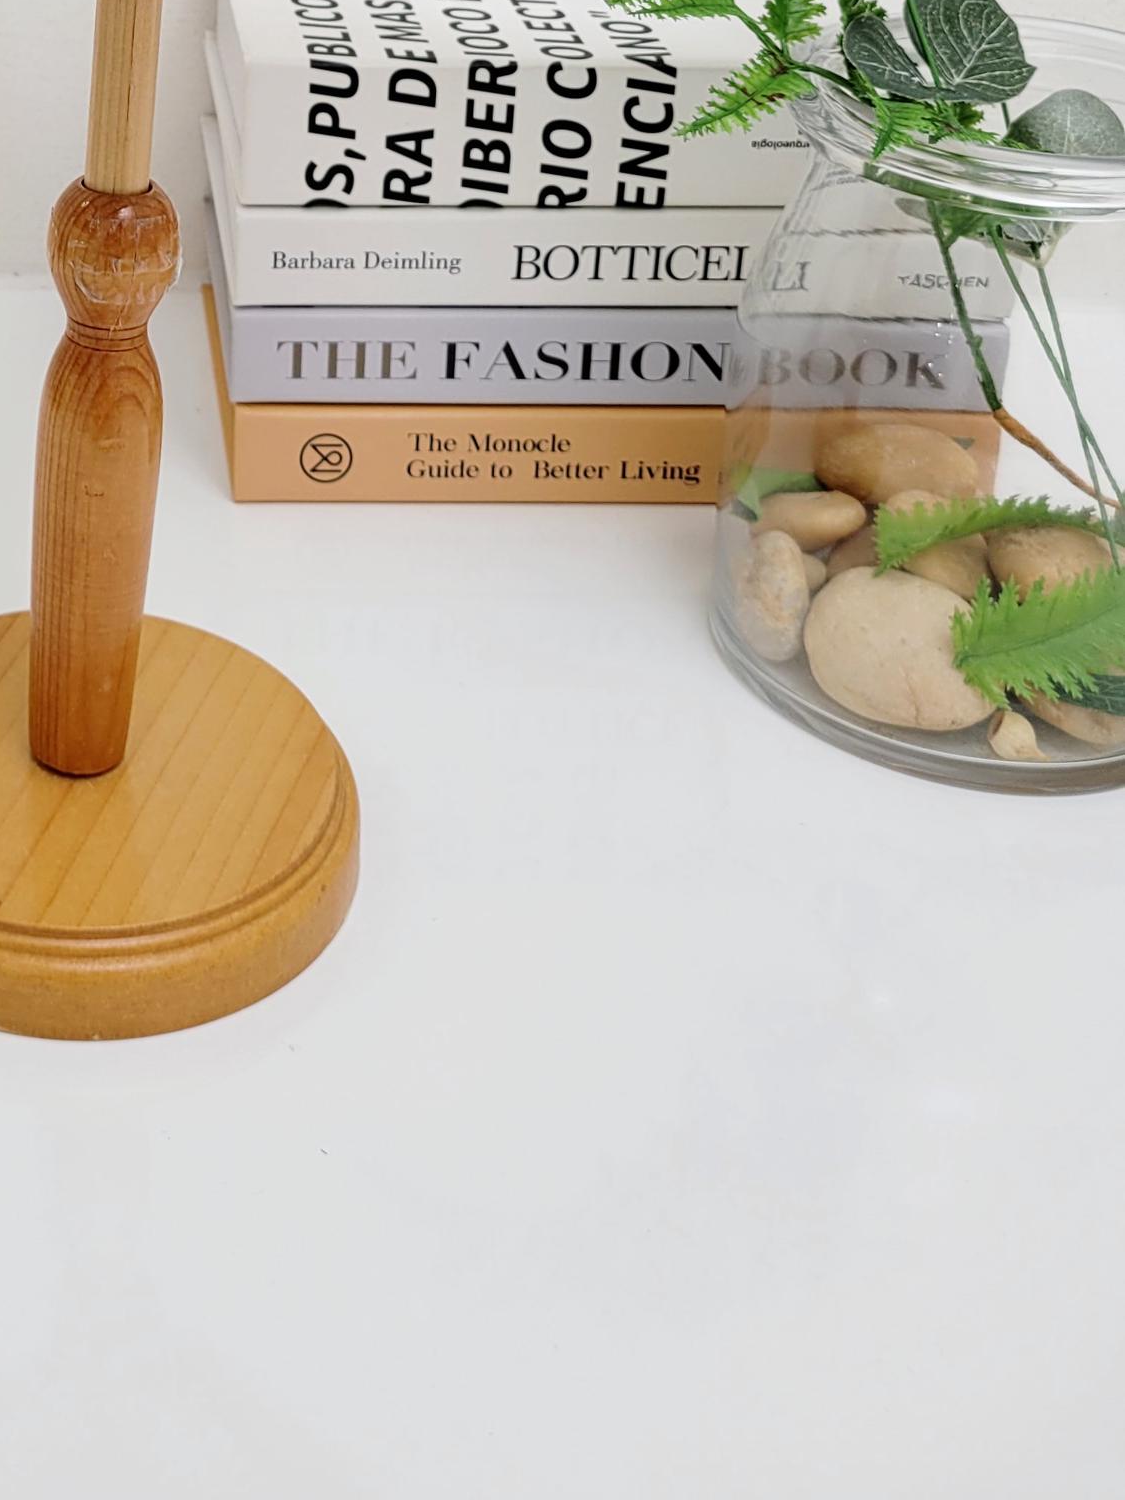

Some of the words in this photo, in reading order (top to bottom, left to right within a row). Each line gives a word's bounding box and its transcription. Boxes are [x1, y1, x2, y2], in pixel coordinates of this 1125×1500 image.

[384, 47, 438, 108] DE
[383, 128, 435, 205] RA
[272, 251, 355, 270] Barbara
[363, 251, 462, 274] Deimling
[276, 341, 417, 380] THE
[439, 341, 731, 381] FASHON
[757, 348, 947, 390] BOOK
[408, 433, 457, 452] The
[467, 433, 571, 452] Monocle
[406, 459, 479, 479] Guide
[490, 461, 513, 479] to
[533, 459, 609, 480] Better
[619, 459, 701, 486] Living
